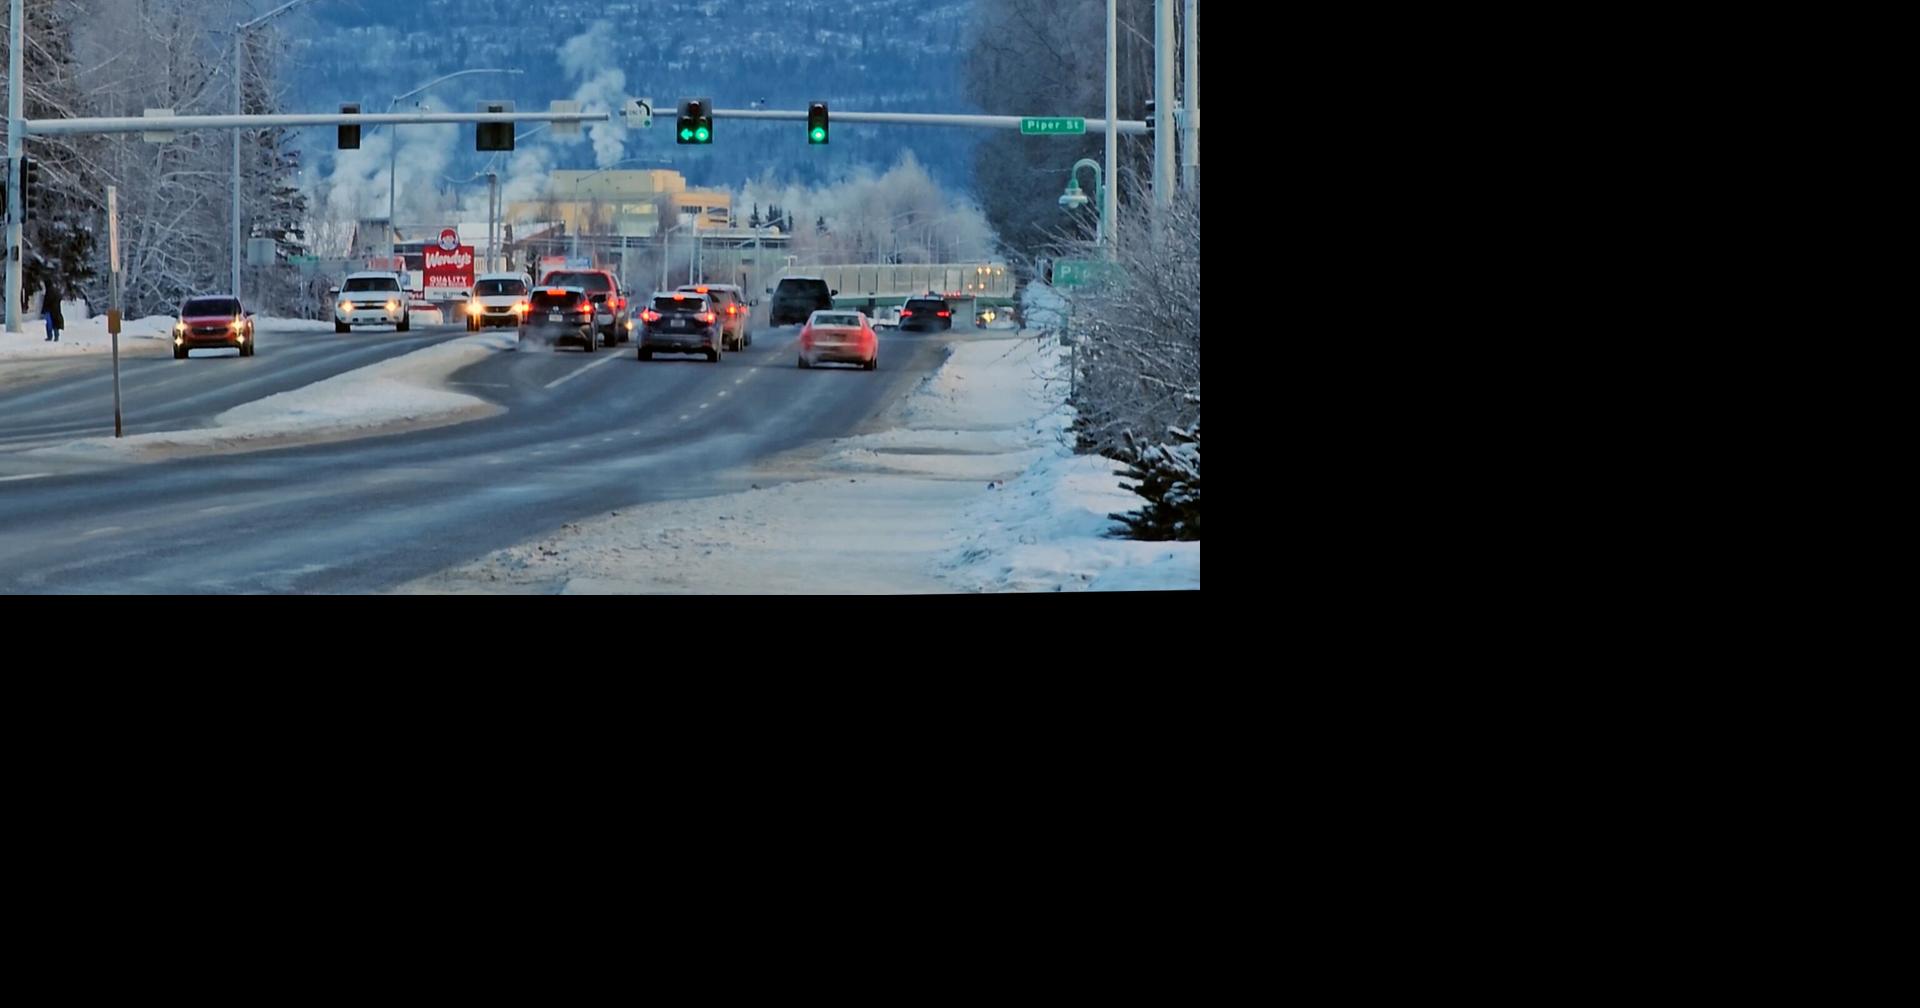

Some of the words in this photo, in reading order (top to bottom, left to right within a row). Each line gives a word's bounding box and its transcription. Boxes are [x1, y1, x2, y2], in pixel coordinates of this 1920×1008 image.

[1027, 120, 1060, 131] Piper
[1066, 120, 1079, 130] St
[425, 249, 471, 269] Wendy's
[429, 275, 467, 284] QUALITY
